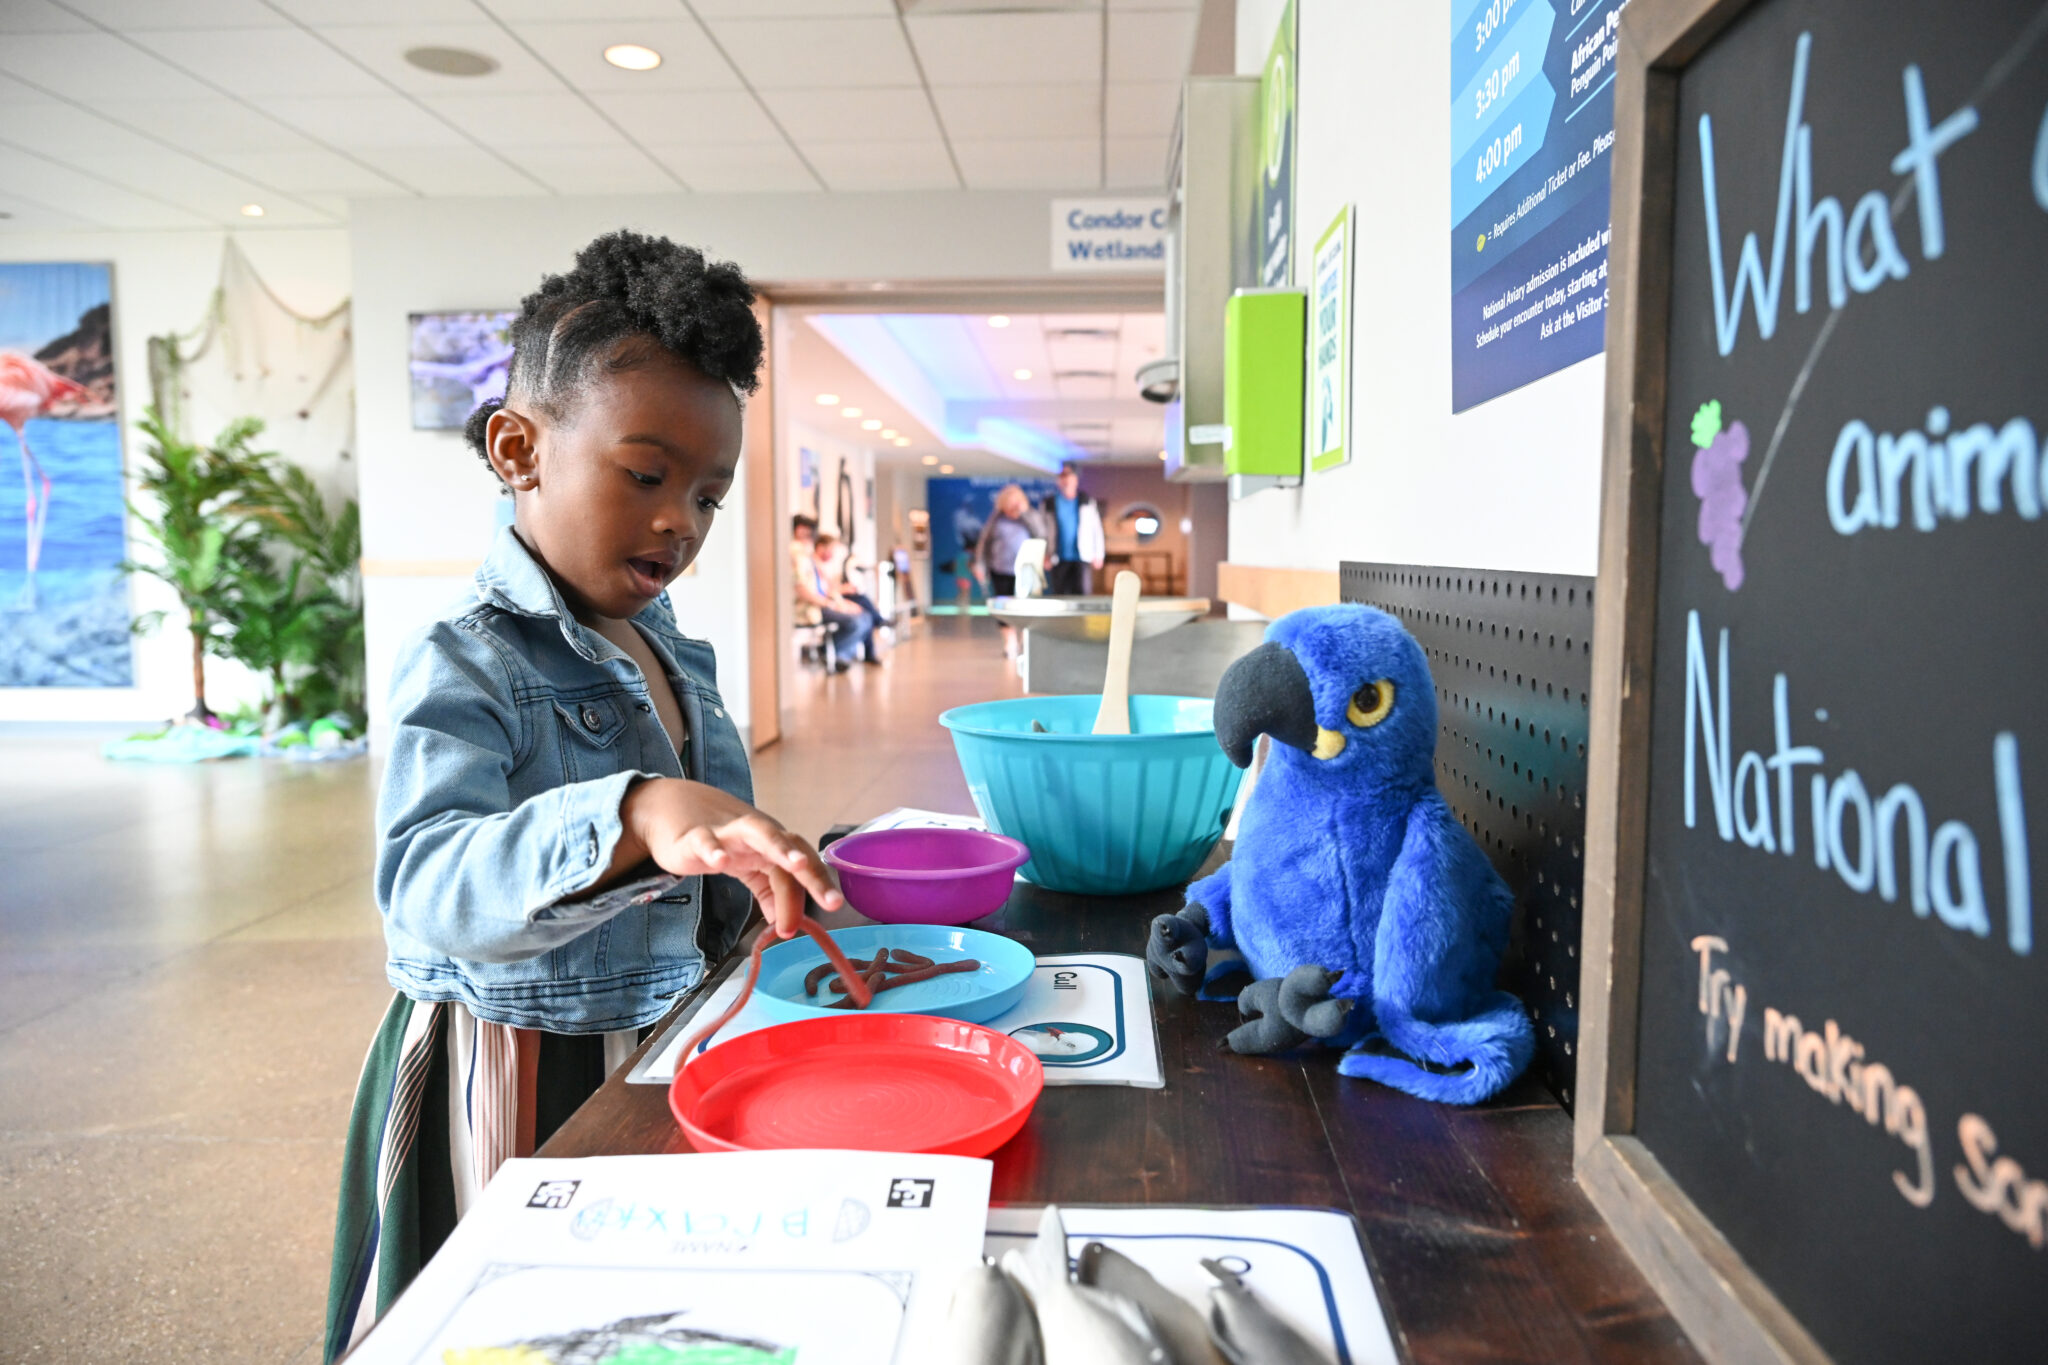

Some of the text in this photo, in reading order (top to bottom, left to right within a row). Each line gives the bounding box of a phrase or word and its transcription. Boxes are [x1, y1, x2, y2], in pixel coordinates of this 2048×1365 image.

[1476, 0, 1500, 52] 3:00
[1571, 25, 1605, 75] African
[1475, 51, 1520, 120] 3:30 pm
[1571, 56, 1601, 98] Penguin
[1476, 122, 1522, 184] 4:00 pm
[1067, 208, 1144, 230] Condor
[1493, 212, 1516, 239] Requires
[1516, 181, 1547, 221] Additional
[1548, 166, 1568, 195] Ticket
[1568, 161, 1577, 179] or
[1577, 150, 1592, 172] Fee.
[1699, 31, 1978, 356] What
[1476, 258, 1608, 348] Schedule your encounter today, starting at
[1482, 293, 1506, 320] National
[1506, 286, 1525, 306] Aviary
[1526, 263, 1559, 294] admission
[1560, 256, 1567, 273] is
[1567, 230, 1600, 268] included
[1540, 318, 1553, 340] Ask
[1554, 315, 1562, 333] at
[1562, 309, 1575, 328] the
[1576, 296, 1603, 321] Visitor
[1826, 405, 2048, 536] anim
[1684, 609, 2031, 956] National
[1053, 971, 1078, 990] Gull
[1690, 934, 1746, 1063] Try
[1763, 1018, 1935, 1208] making
